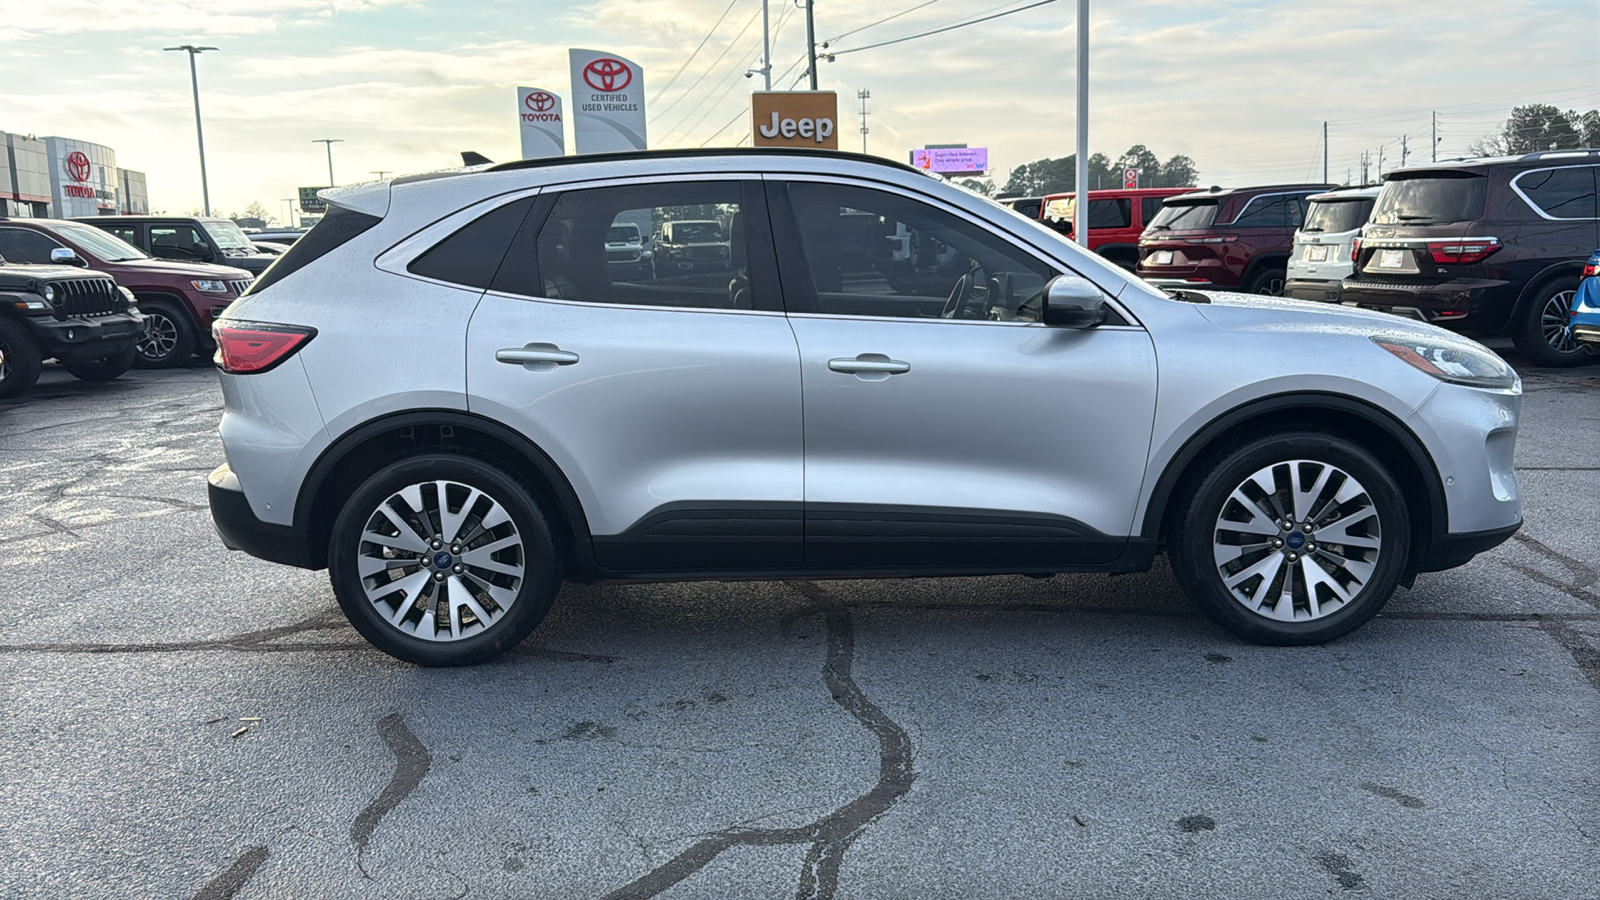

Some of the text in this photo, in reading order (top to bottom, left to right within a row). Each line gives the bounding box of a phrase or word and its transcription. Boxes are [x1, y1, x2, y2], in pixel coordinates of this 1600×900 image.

[591, 94, 628, 102] CERTIFIED
[582, 104, 638, 112] USED VEHICLES
[521, 113, 562, 122] TOYOTA
[760, 111, 834, 143] Jeep
[65, 185, 95, 198] TOYOTA
